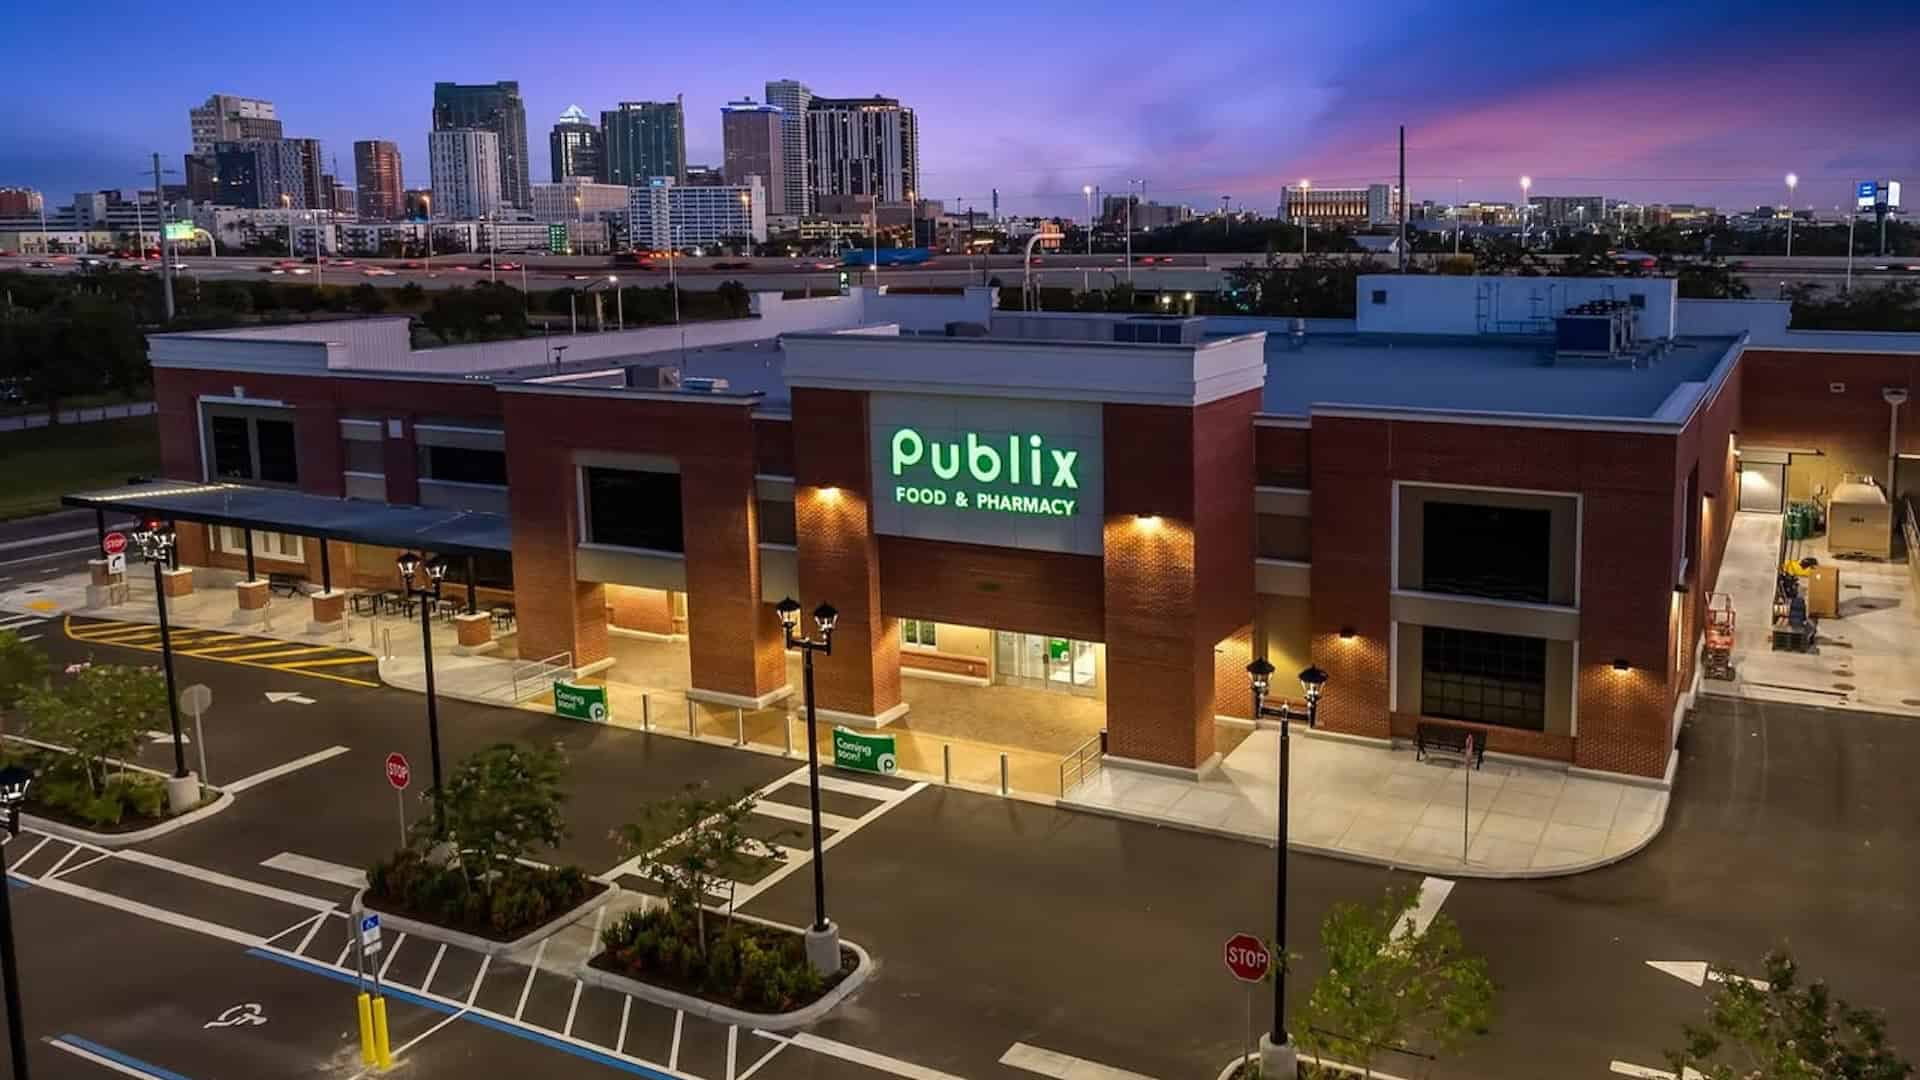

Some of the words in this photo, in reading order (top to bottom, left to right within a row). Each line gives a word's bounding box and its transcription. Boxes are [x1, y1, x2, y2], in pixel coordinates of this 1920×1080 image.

[892, 428, 1078, 489] Publix
[895, 486, 947, 506] FOOD
[955, 491, 969, 508] &
[977, 493, 1075, 516] PHARMACY
[836, 737, 872, 757] Coming
[389, 762, 409, 779] STOP
[1228, 946, 1267, 969] STOP
